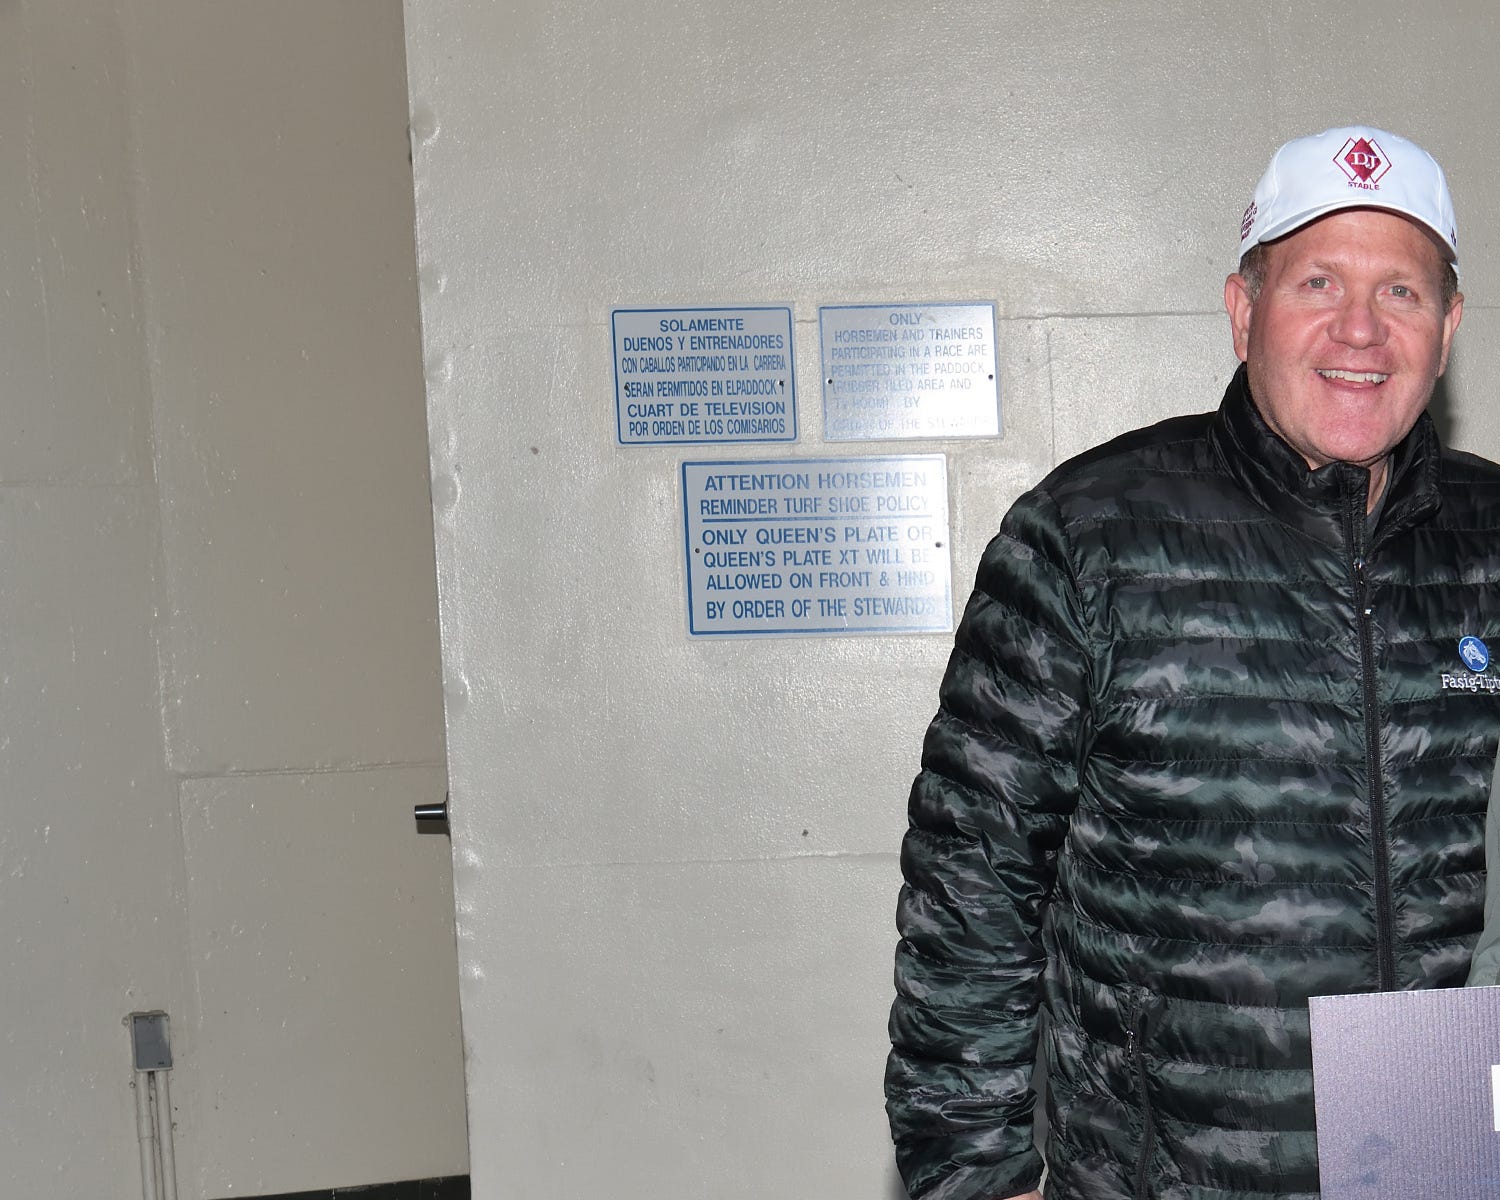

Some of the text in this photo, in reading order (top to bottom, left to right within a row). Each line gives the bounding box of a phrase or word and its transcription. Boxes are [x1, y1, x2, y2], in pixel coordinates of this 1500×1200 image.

[1351, 152, 1380, 169] DJ
[1348, 182, 1380, 190] STABLE
[660, 318, 744, 332] SOLAMENTE
[889, 313, 922, 325] ONLY
[623, 334, 784, 351] DUENOS Y ENTRENADORES
[834, 328, 983, 342] HORSEMEN AND TRAINERS
[832, 344, 988, 360] PARTICIPATING IN A RACE ARE
[622, 354, 786, 374] CON CABALLOS PARTICIPANDO EN LA CARRERA
[910, 363, 930, 375] THE
[934, 362, 985, 374] PADDOCK
[624, 382, 654, 398] SERAN
[657, 380, 708, 397] PERMITIDOS
[712, 380, 724, 396] EN
[917, 379, 945, 390] AREA
[950, 378, 972, 390] AND
[628, 402, 785, 418] CUART DE TELEVISION
[630, 418, 785, 436] POR ORDEN DE LOS COMISARIOS
[704, 472, 927, 491] ATTENTION HORSEMEN
[701, 496, 928, 516] REMINDER TURF SHOE POLICY
[702, 526, 932, 546] ONLY QUEEN'S PLATE OR
[704, 550, 776, 568] QUEEN'S
[784, 550, 832, 566] PLATE
[840, 550, 860, 565] XT
[867, 549, 904, 564] WILL
[706, 570, 935, 590] ALLOWED ON FRONT & HIND
[706, 596, 936, 620] BY ORDER OF THE STEWARDS
